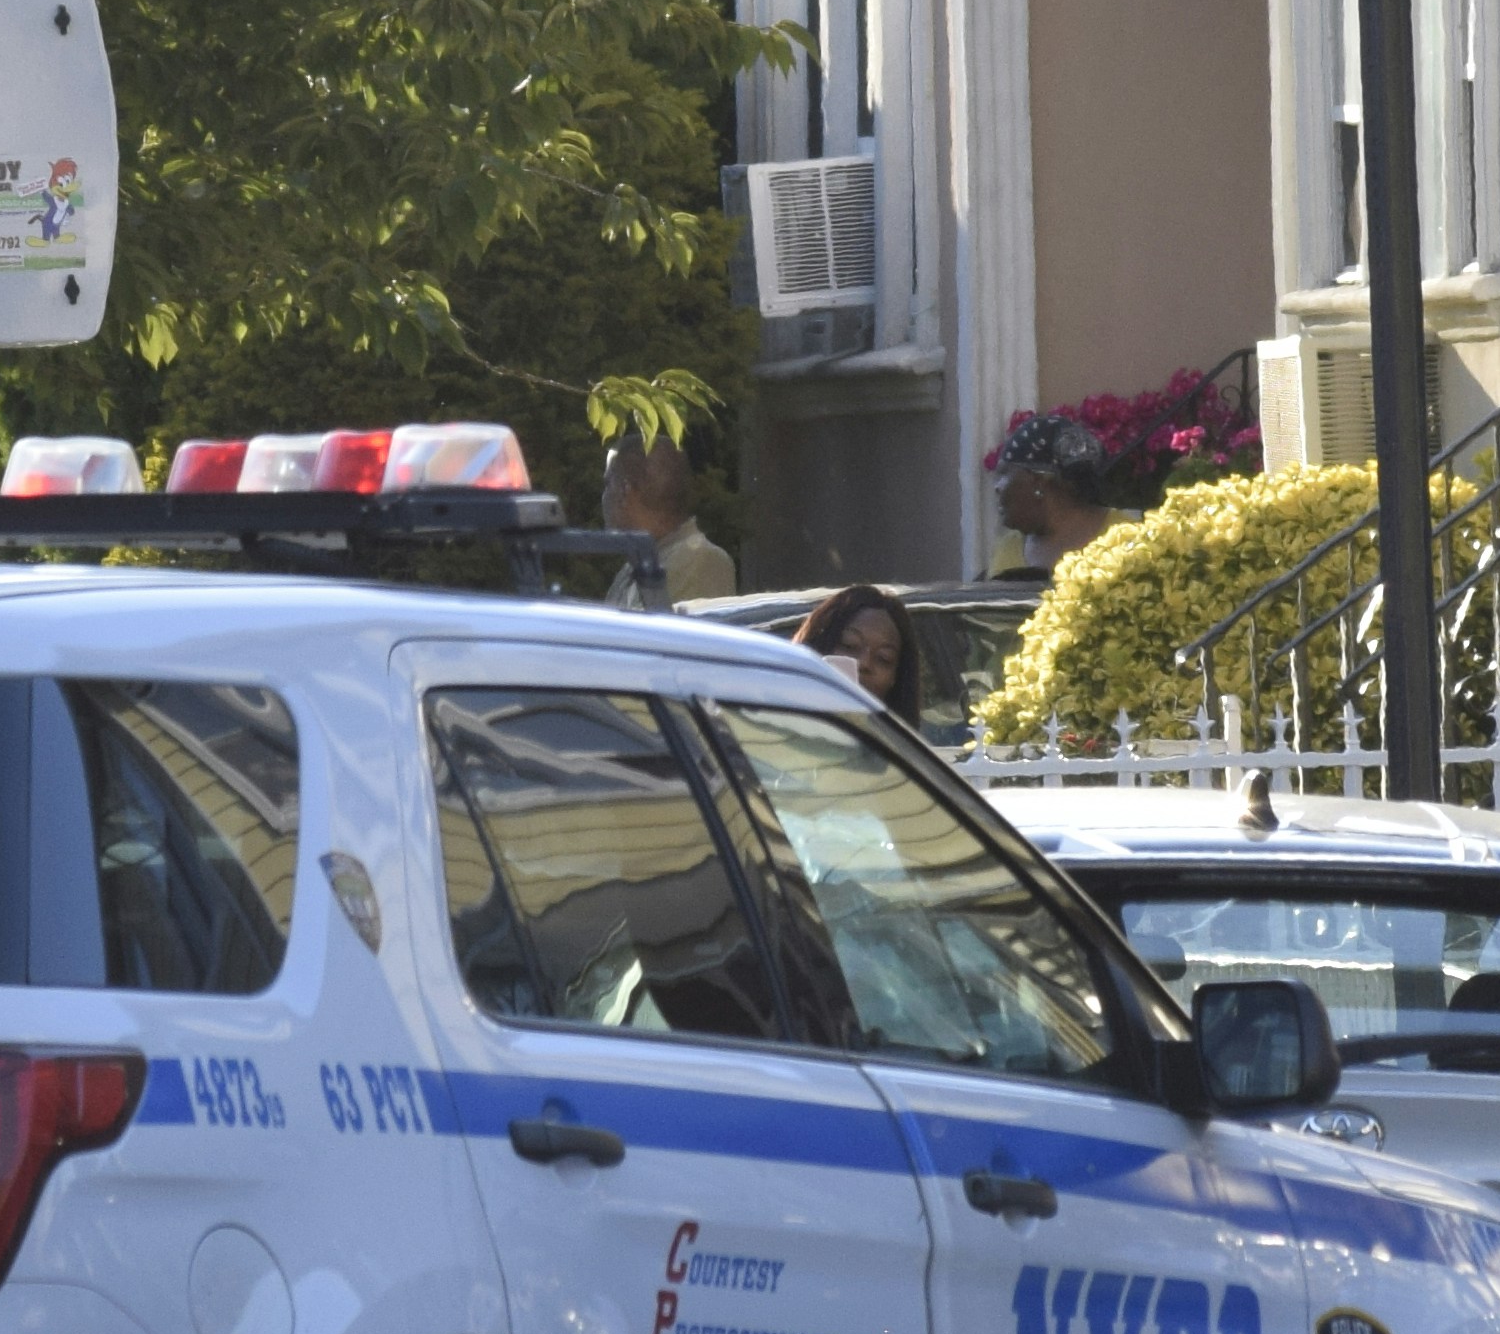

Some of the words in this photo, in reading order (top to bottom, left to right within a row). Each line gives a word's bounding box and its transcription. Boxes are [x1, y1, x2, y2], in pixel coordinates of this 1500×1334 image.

[193, 1058, 269, 1130] 4873
[319, 1062, 364, 1134] 63
[665, 1219, 786, 1294] COURTESY
